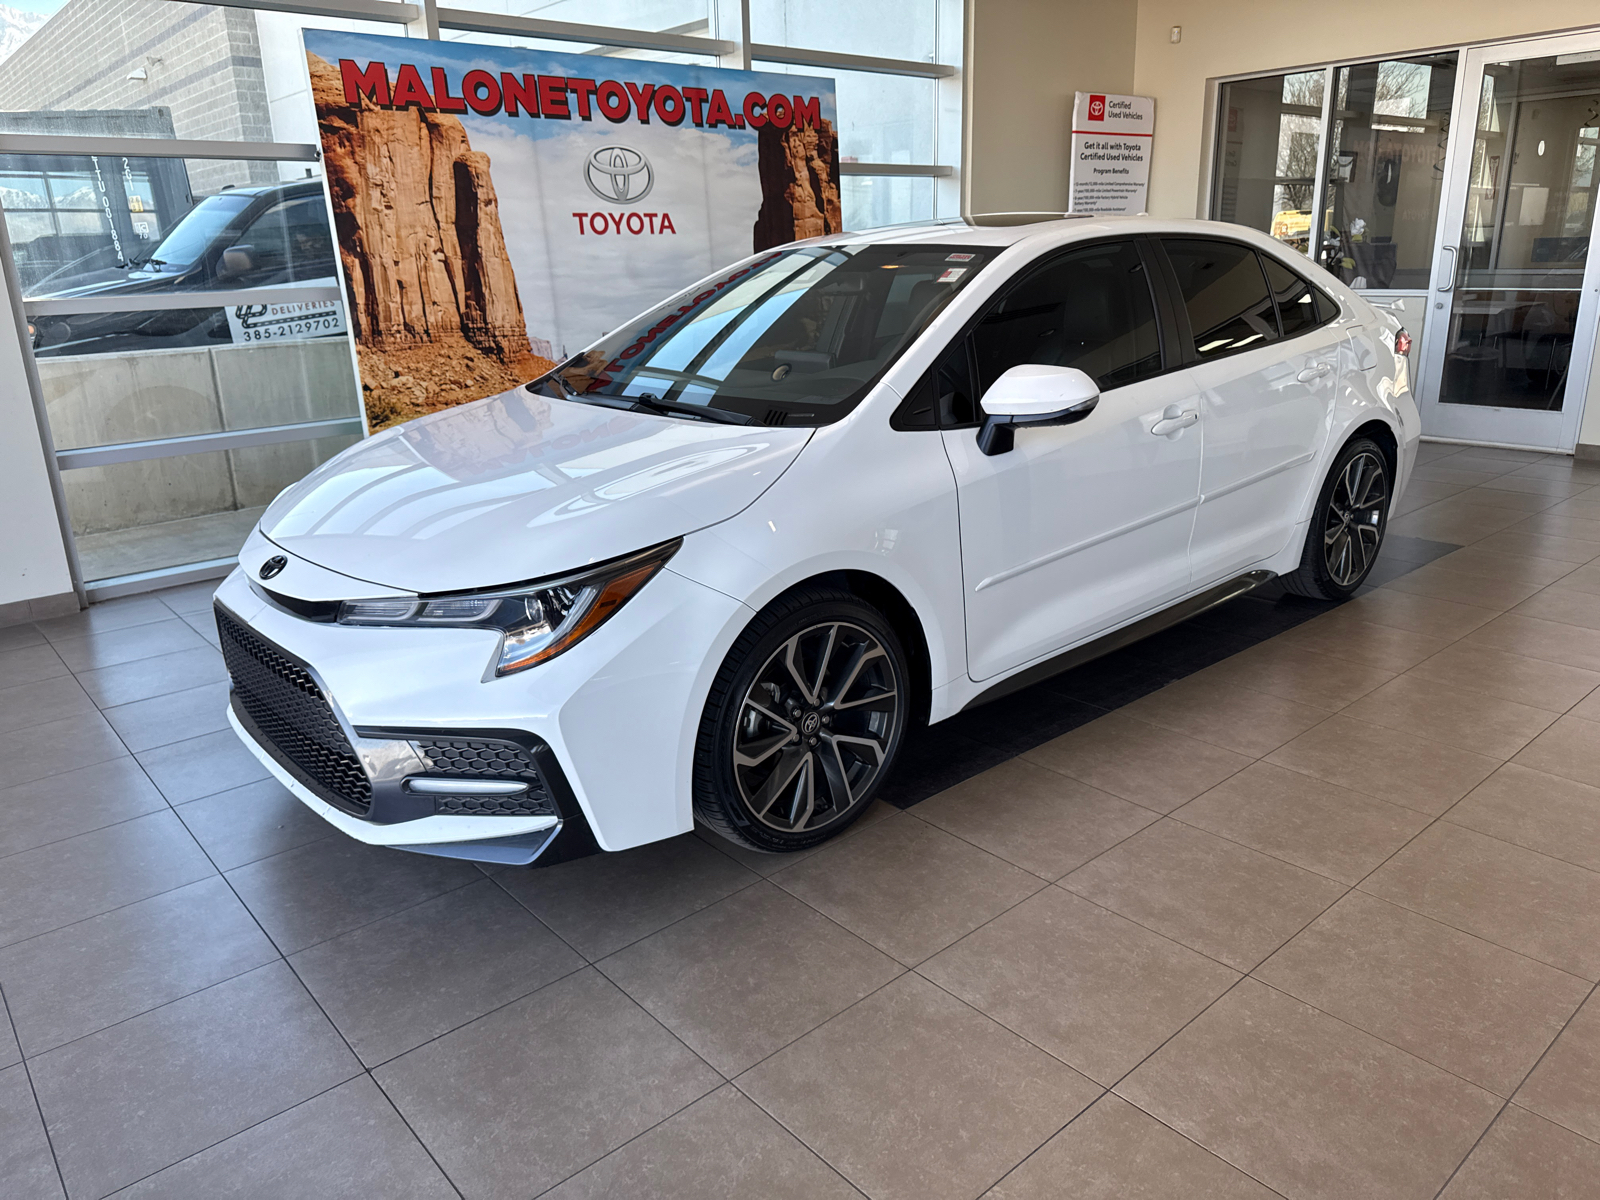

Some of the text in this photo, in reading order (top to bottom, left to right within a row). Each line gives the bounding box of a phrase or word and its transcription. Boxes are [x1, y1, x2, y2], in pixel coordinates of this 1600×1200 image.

[339, 59, 821, 130] MALONETOYOTA.COM
[1108, 101, 1131, 110] Certified
[1108, 110, 1143, 120] Used Vehicles
[1084, 141, 1095, 150] Get
[1096, 142, 1100, 150] it
[1110, 142, 1122, 150] with
[1123, 142, 1141, 152] Toyota
[1080, 152, 1143, 162] Certified Used Vehicles
[1093, 167, 1111, 175] Program
[572, 212, 677, 235] TOYOTA
[271, 300, 335, 316] DELIVERIES
[243, 317, 339, 342] 385-2129702
